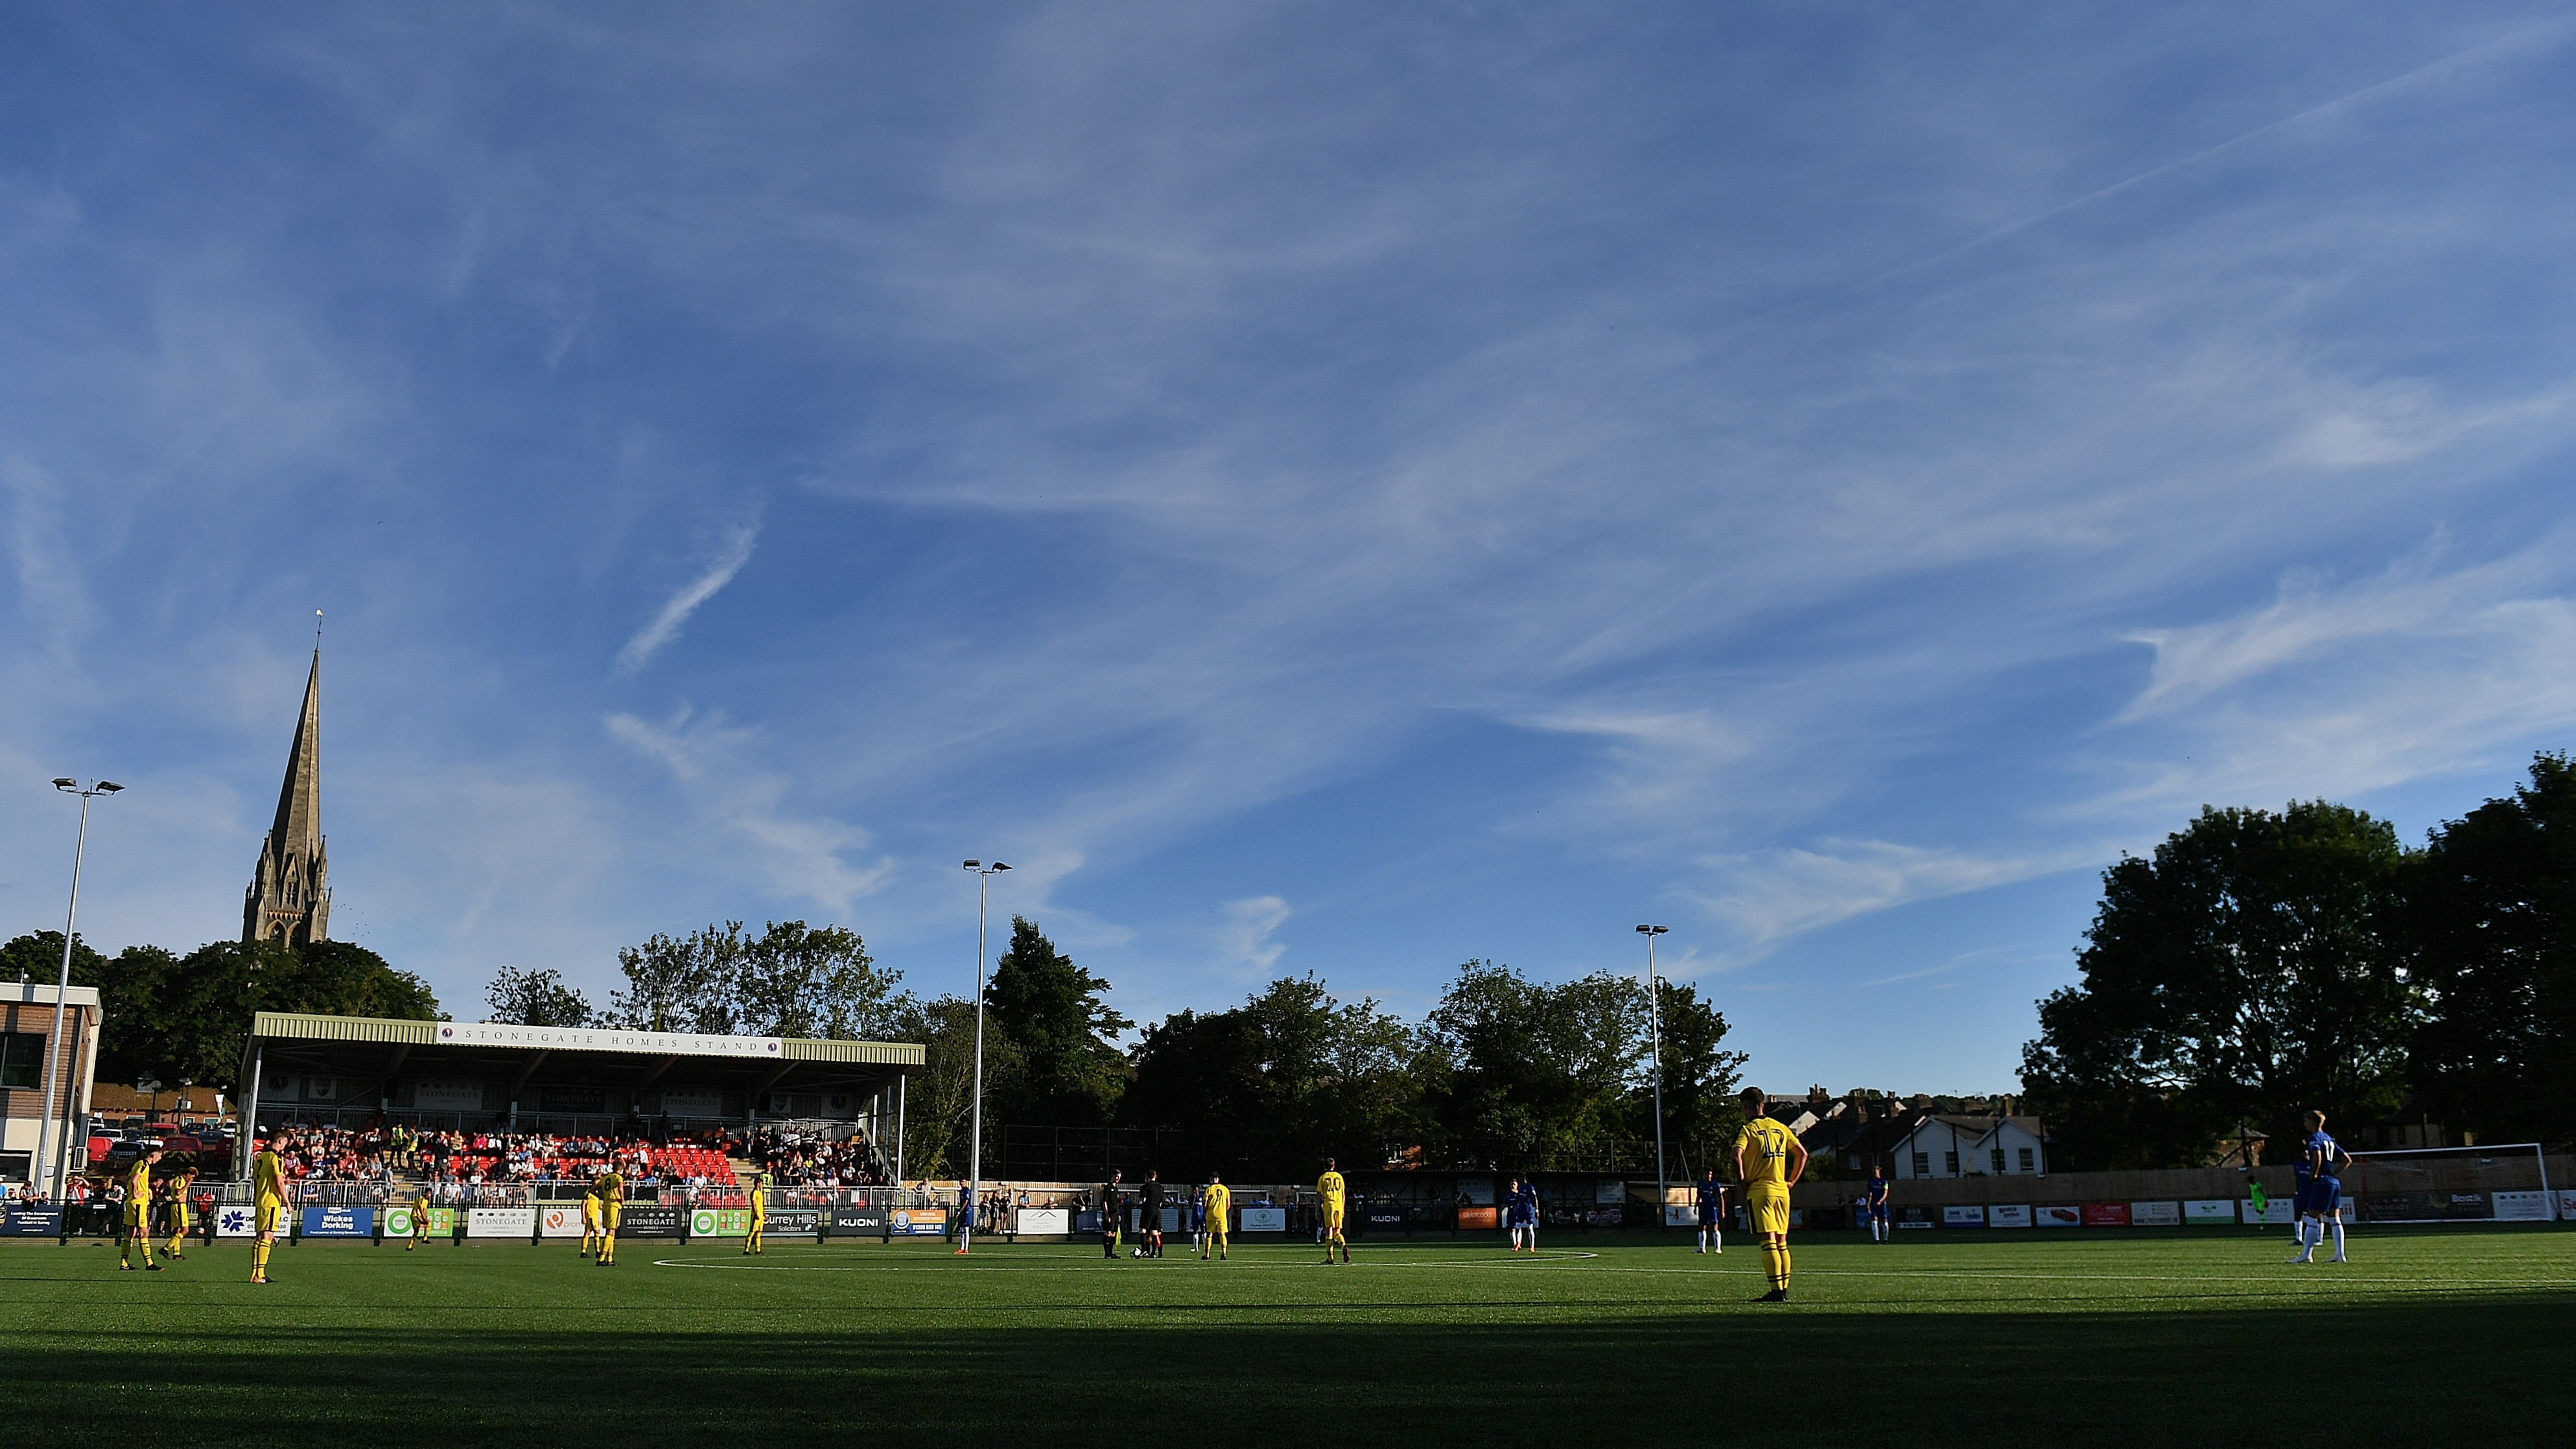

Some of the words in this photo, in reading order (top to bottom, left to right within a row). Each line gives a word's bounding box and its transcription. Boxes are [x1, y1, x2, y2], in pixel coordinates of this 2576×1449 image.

[465, 1030, 594, 1044] STONEGATE
[611, 1037, 679, 1048] HOMES
[695, 1041, 758, 1050] STAND
[605, 1177, 611, 1192] 8
[797, 1214, 817, 1225] Hills
[1463, 1211, 1493, 1219] taylorcocks
[322, 1222, 354, 1230] Dorking
[838, 1218, 879, 1227] KUONI
